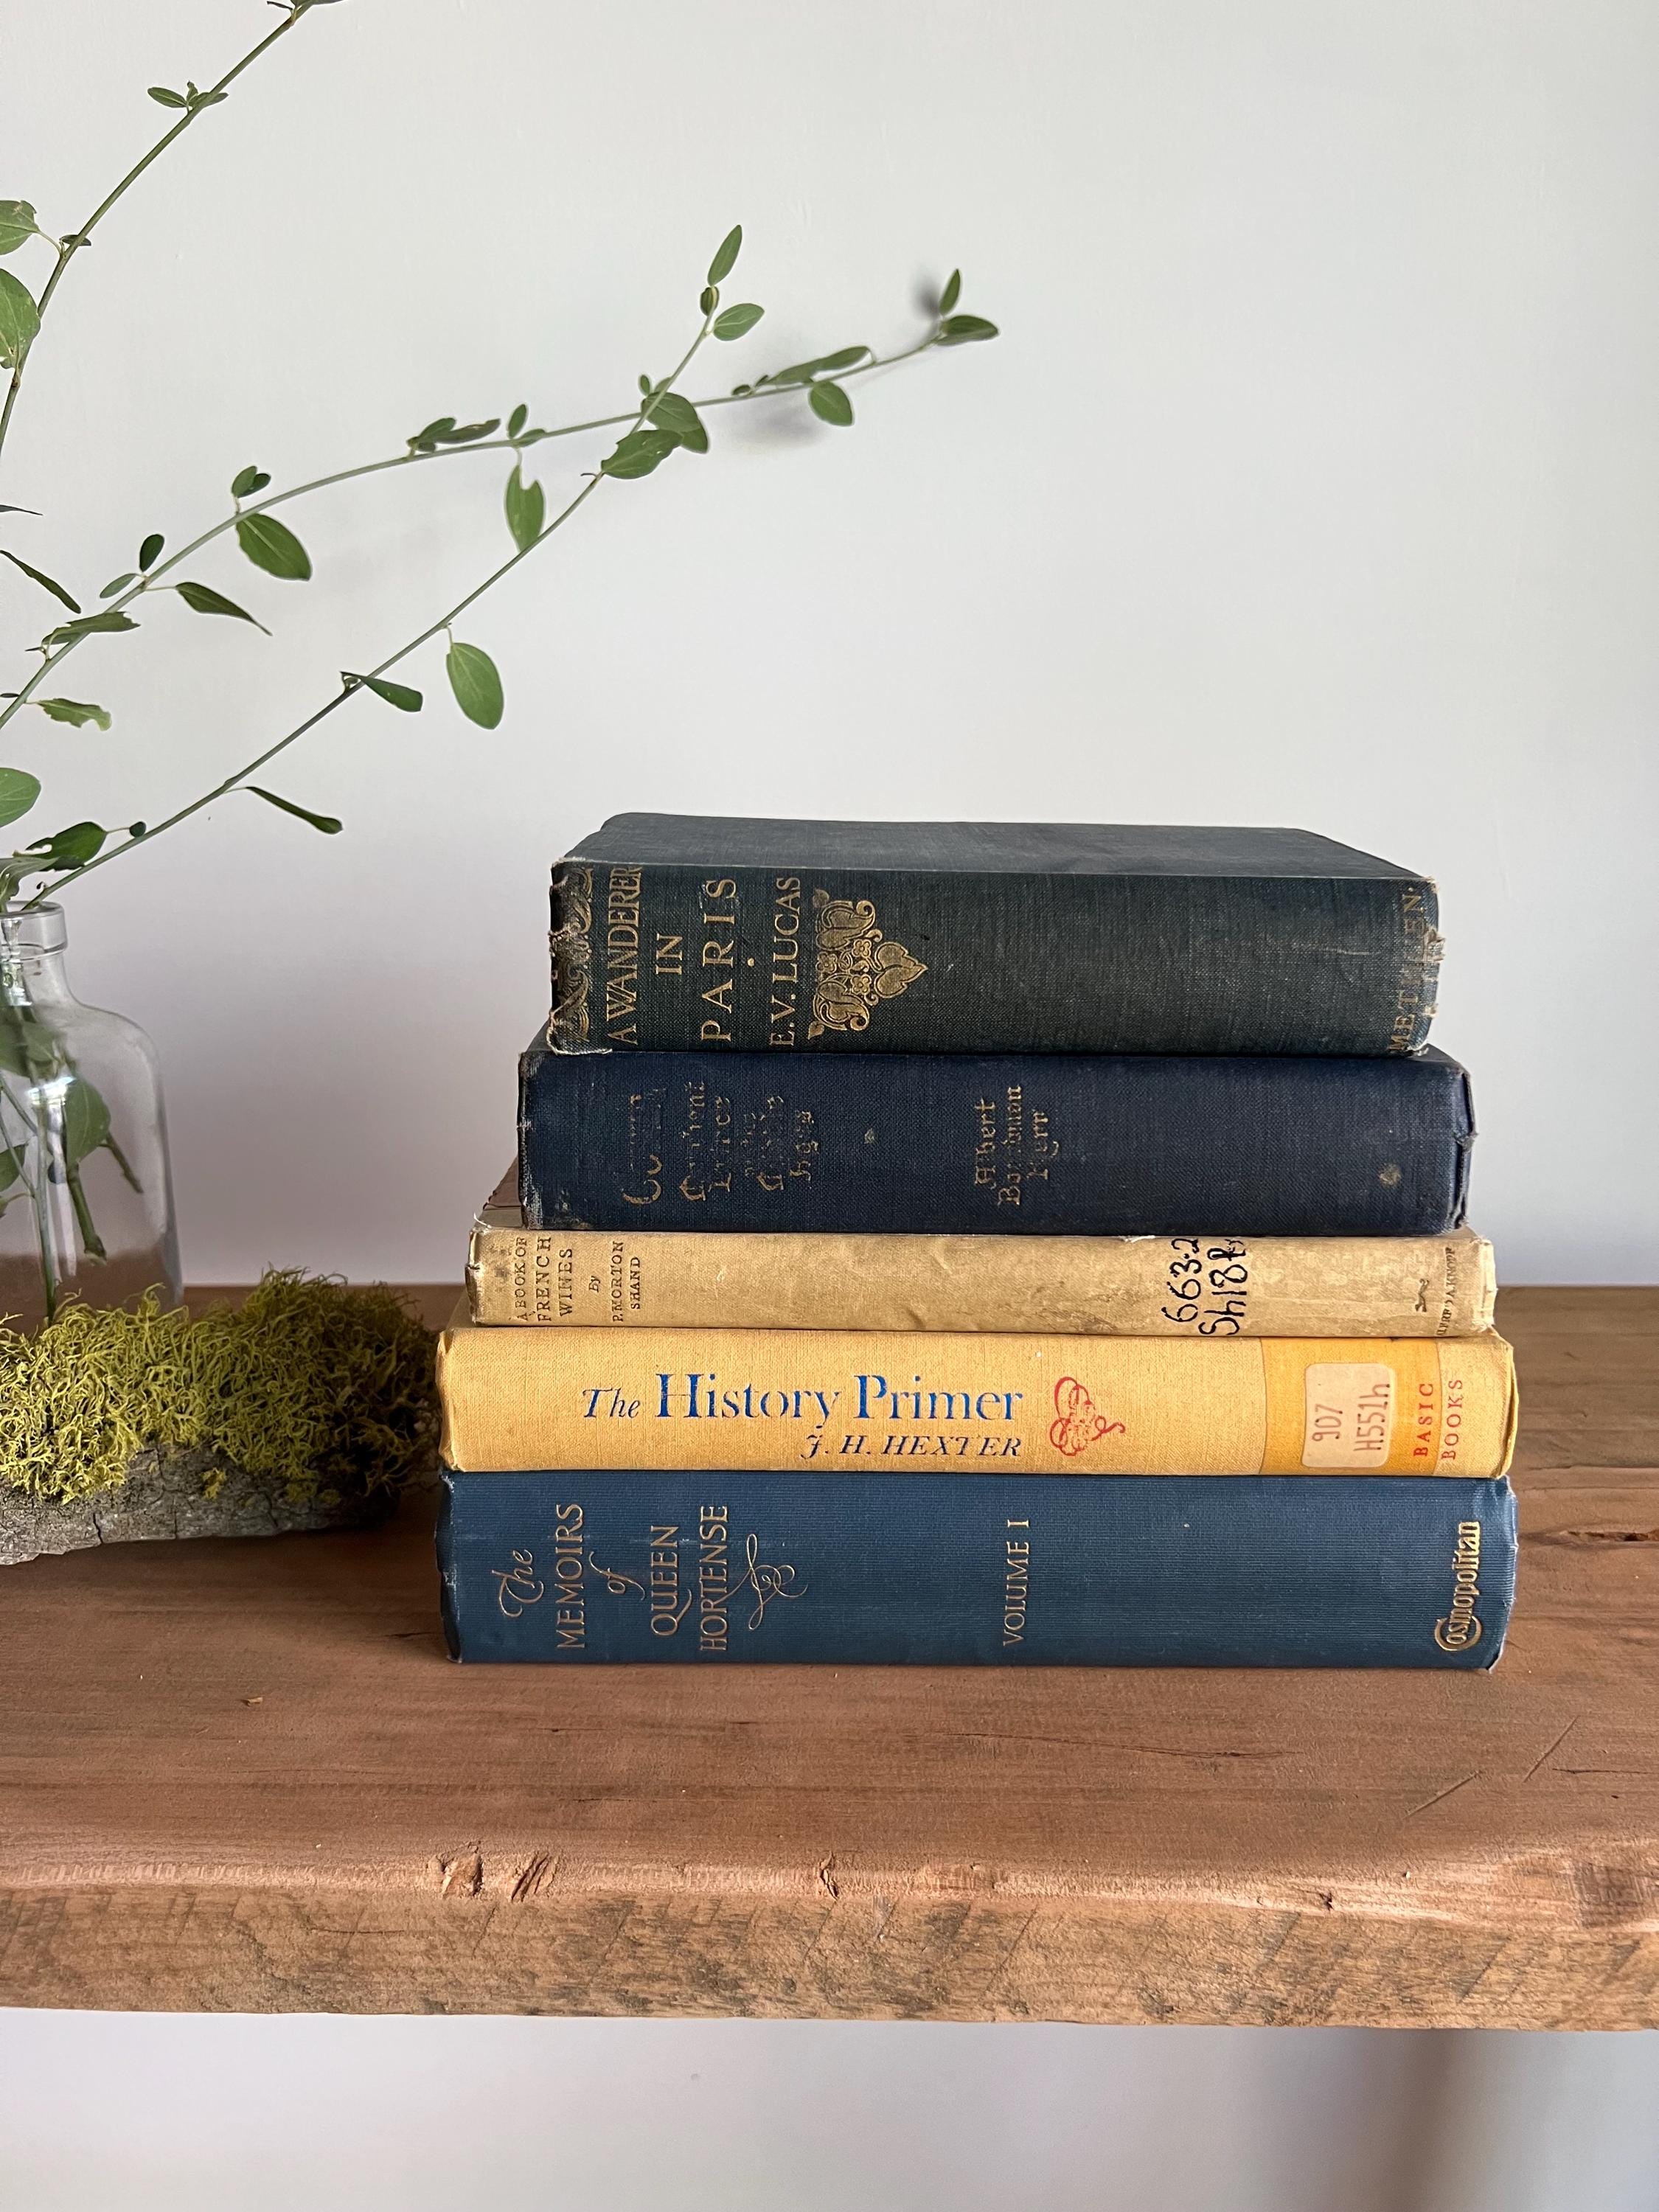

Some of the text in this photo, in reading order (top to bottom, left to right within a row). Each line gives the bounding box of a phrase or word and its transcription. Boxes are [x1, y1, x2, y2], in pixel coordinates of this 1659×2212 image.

[605, 866, 643, 1046] A WANDERER
[655, 933, 683, 975] IN
[700, 878, 737, 1042] PARIS
[772, 877, 801, 984] LUCAS
[536, 1237, 552, 1322] FRENCH
[557, 1248, 573, 1316] WINES
[589, 1275, 602, 1293] By
[630, 1256, 640, 1310] SHAND
[581, 1373, 1023, 1429] The History Primer
[1311, 1403, 1343, 1442] 907
[1413, 1382, 1434, 1458] BASIC
[1441, 1379, 1464, 1461] BOOKS
[882, 1435, 1022, 1458] HEXTER
[490, 1548, 545, 1618] The
[554, 1503, 586, 1650] MEMOIRS
[589, 1551, 646, 1601] of
[650, 1525, 693, 1636] QUEEN
[698, 1504, 729, 1652] HORTENSE
[1002, 1518, 1030, 1646] VOLUME I
[1433, 1520, 1482, 1652] Cosmopolitan
